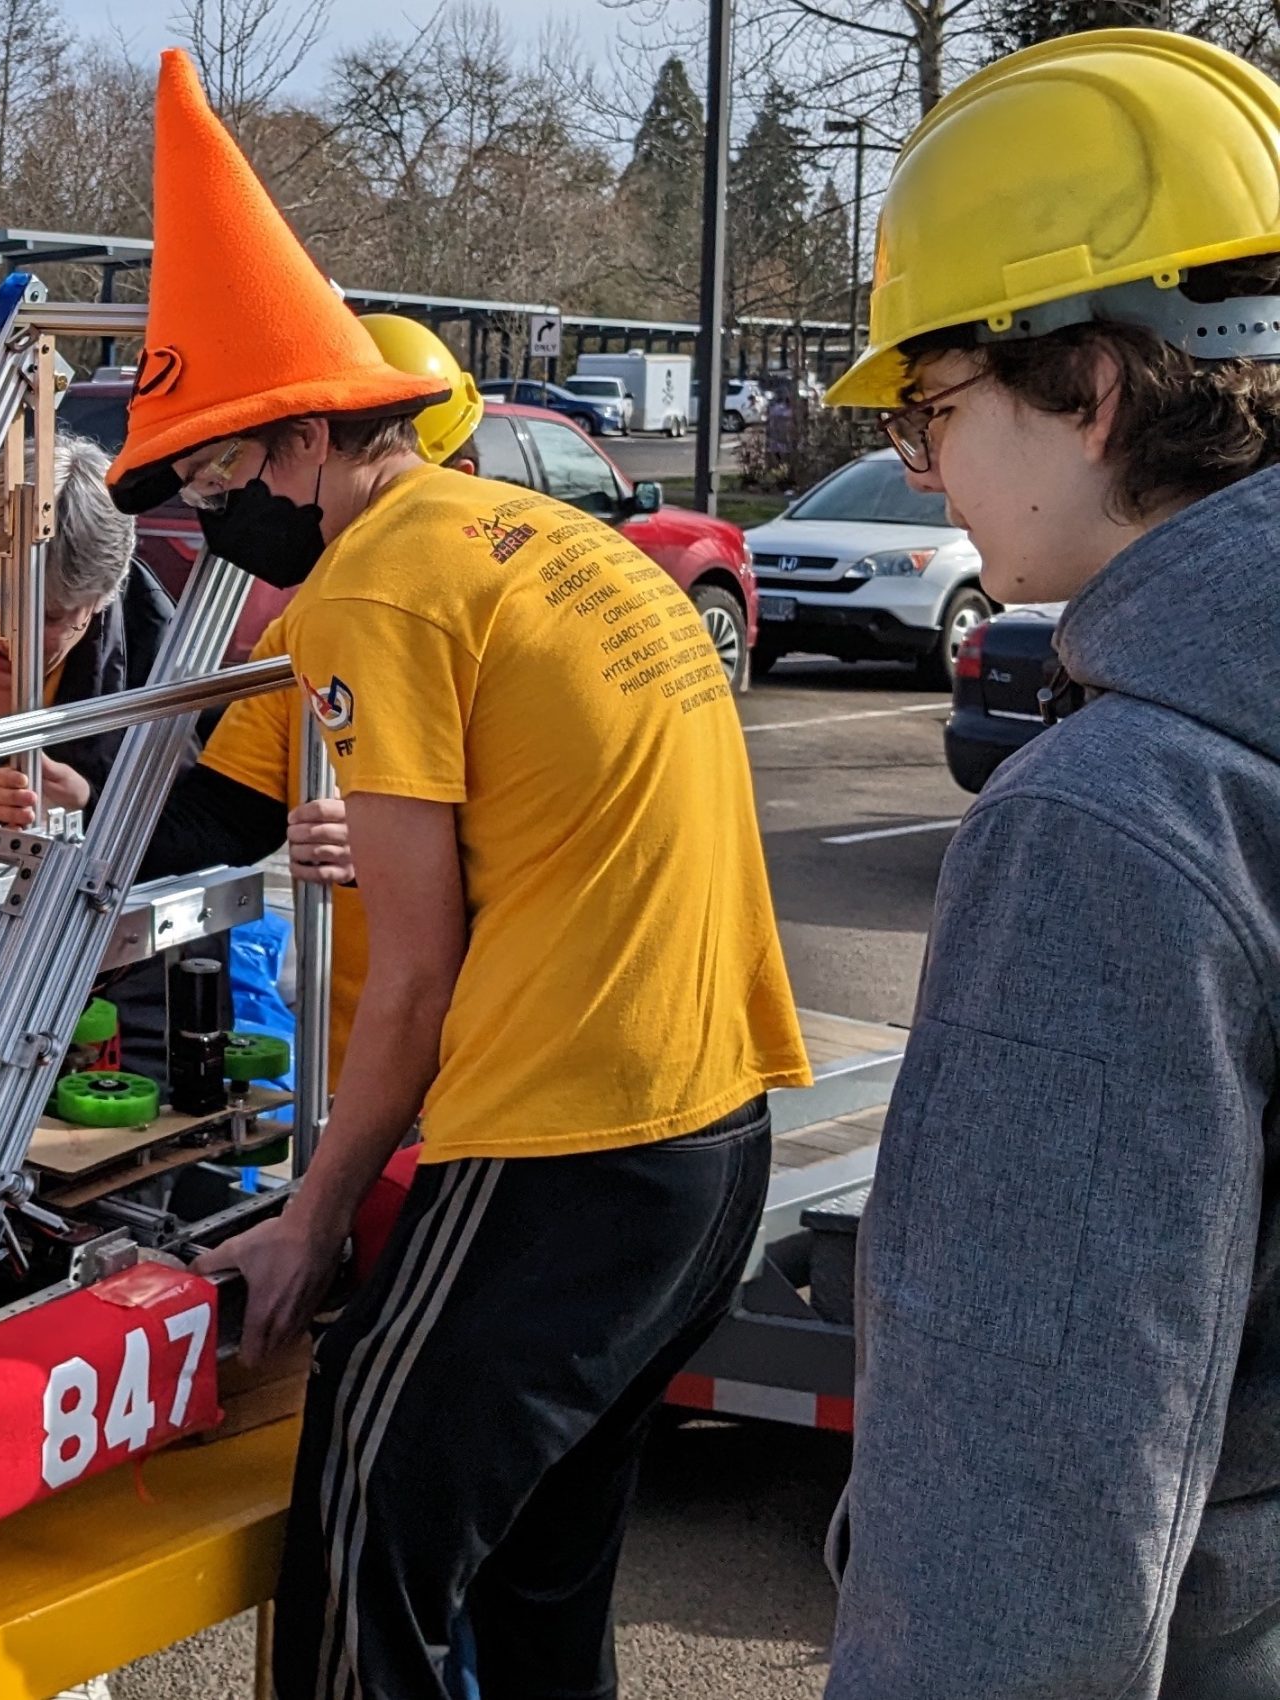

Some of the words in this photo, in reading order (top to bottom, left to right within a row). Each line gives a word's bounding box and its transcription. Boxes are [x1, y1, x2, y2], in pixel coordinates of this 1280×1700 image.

[534, 343, 557, 352] ONLY
[538, 555, 568, 583] IBEW
[545, 561, 602, 607] MICROCHIP
[575, 583, 621, 617] FASTENAL
[602, 591, 646, 625] CORVALLIS
[600, 621, 645, 655] FIGARO'S
[601, 655, 635, 682] HYTEK
[631, 636, 669, 664] PLASTICS
[619, 659, 671, 696] PHILOMATH
[41, 1301, 212, 1490] 847
